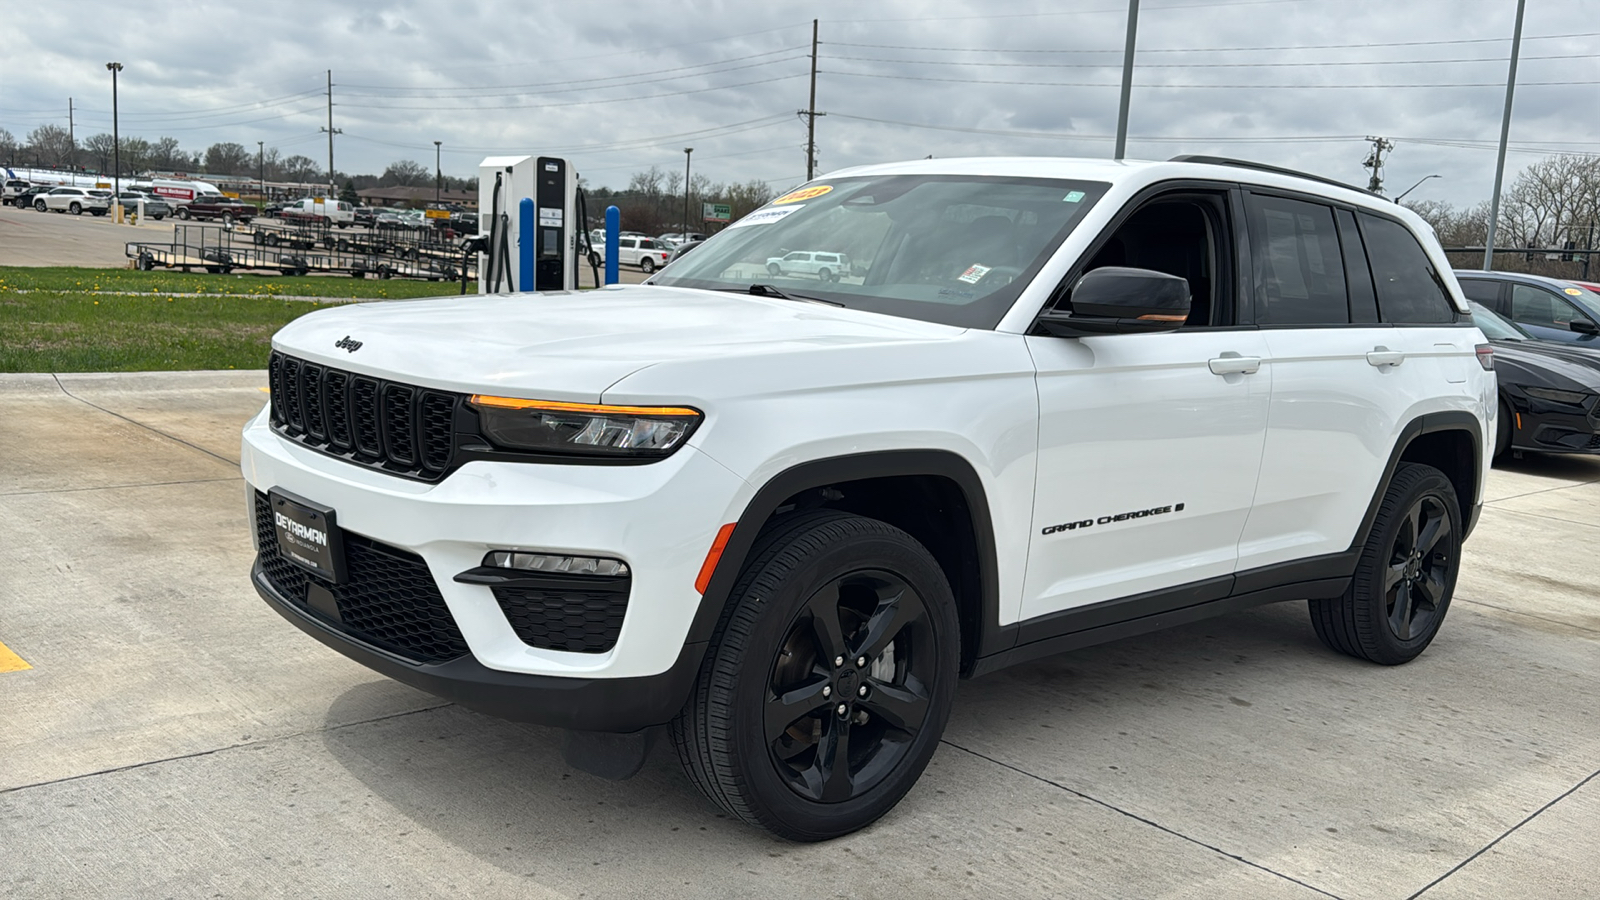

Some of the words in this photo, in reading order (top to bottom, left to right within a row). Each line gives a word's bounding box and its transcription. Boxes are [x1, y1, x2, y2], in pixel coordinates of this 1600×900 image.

[335, 335, 363, 353] Jeep
[275, 512, 327, 546] DEYARMAN
[1042, 519, 1093, 535] GRAND
[1097, 505, 1172, 525] CHEROKEE
